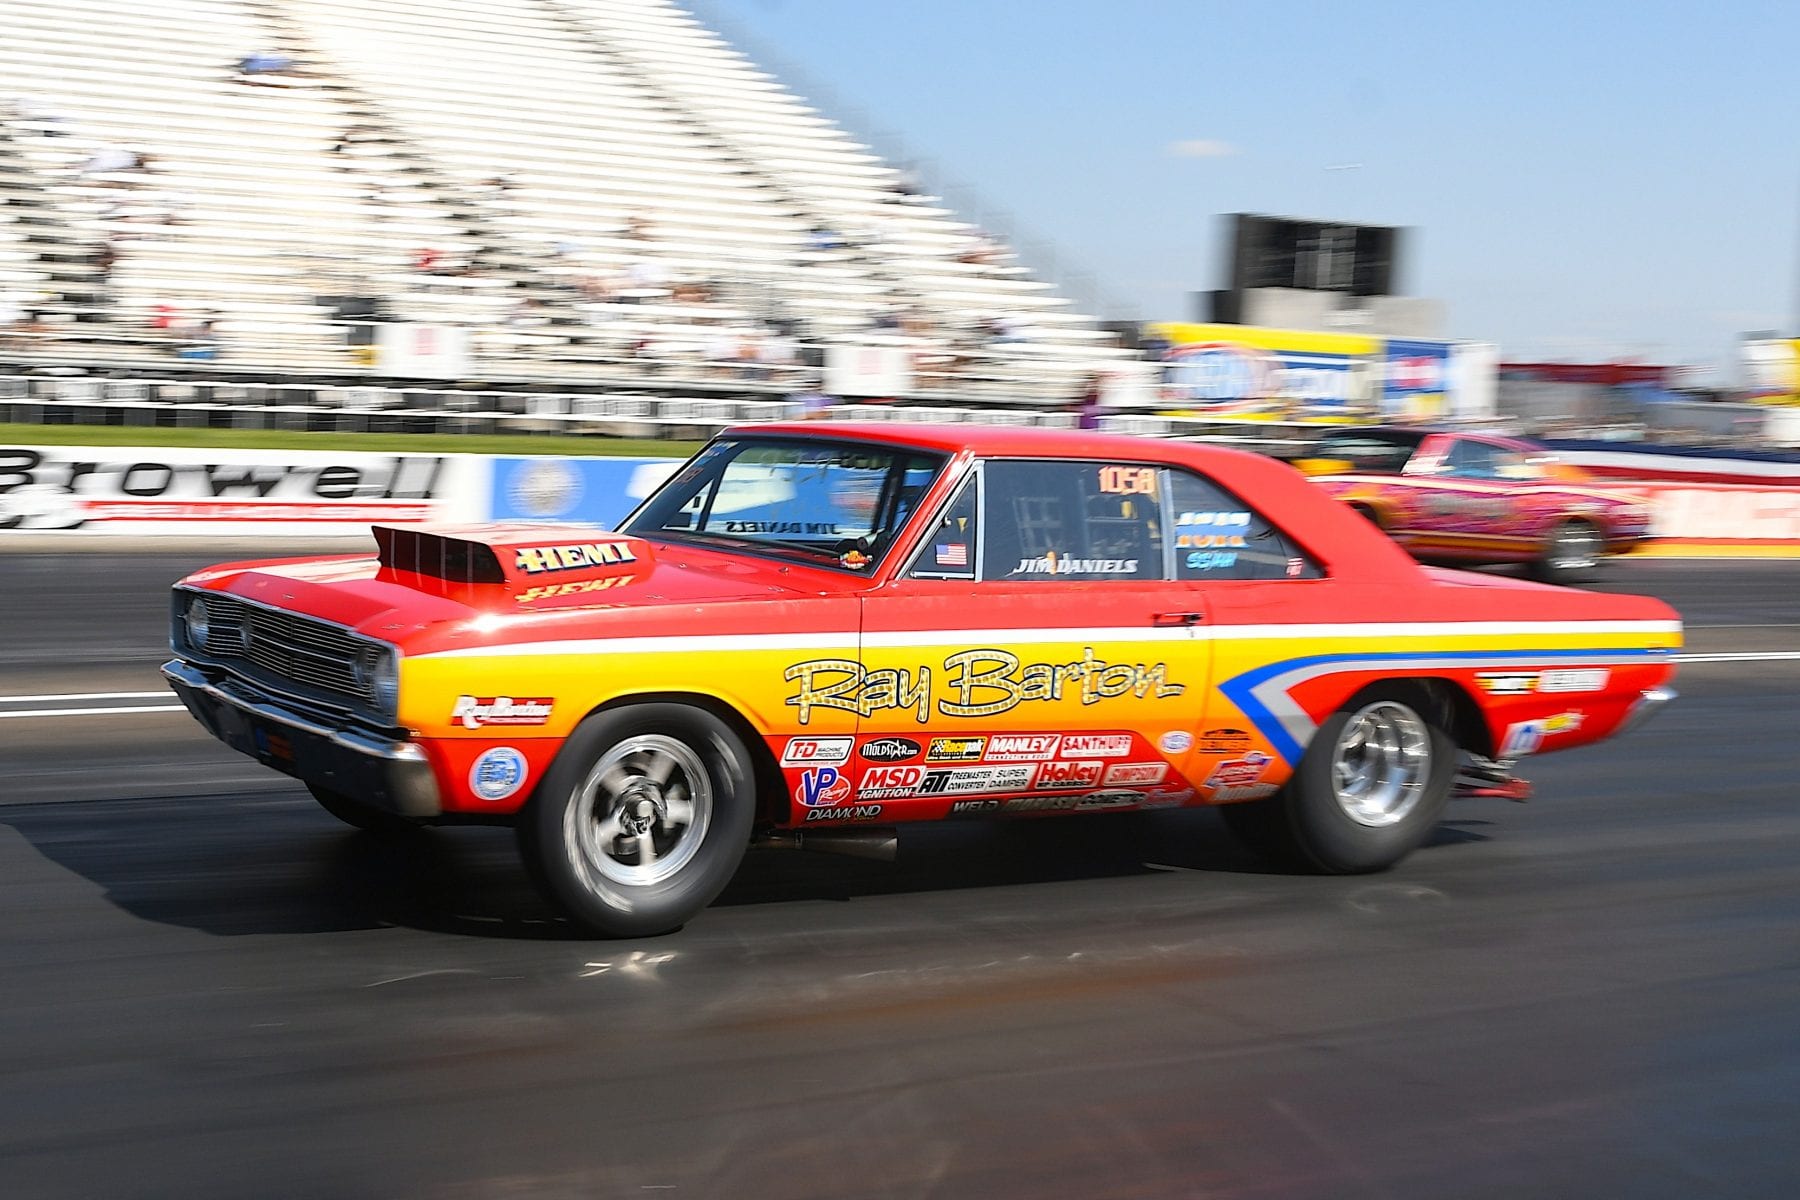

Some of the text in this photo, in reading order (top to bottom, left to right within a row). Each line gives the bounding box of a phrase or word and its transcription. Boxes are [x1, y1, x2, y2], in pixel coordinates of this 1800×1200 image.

[0, 449, 440, 498] Browell
[1098, 465, 1155, 494] 1058
[515, 542, 637, 573] HEMI
[1004, 557, 1138, 577] JIM DANIELS
[784, 646, 1187, 724] Ray Barton
[990, 737, 1053, 752] MANLEY
[864, 768, 921, 788] MSD
[996, 768, 1028, 778] SUPER
[1040, 763, 1101, 781] Holley
[802, 767, 839, 806] VP
[947, 781, 986, 791] CONVERTER
[988, 779, 1028, 788] DAMPER
[858, 788, 912, 800] IGNITION
